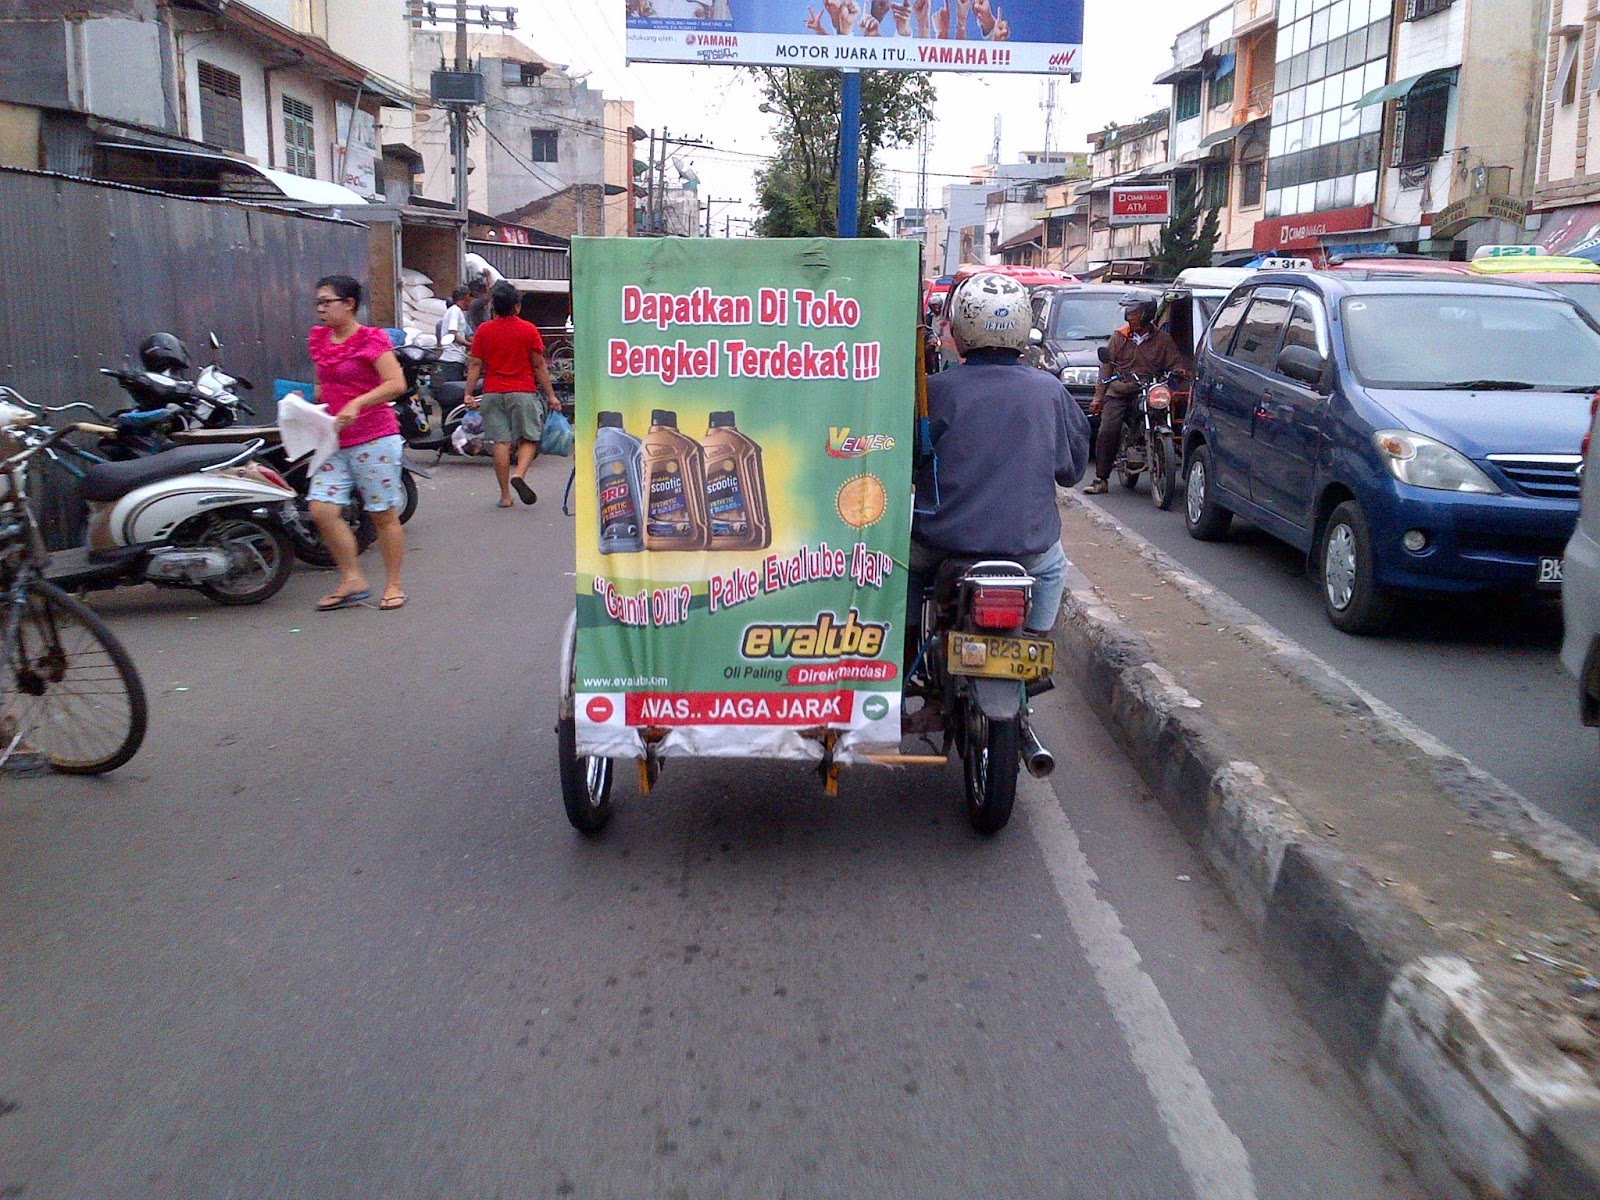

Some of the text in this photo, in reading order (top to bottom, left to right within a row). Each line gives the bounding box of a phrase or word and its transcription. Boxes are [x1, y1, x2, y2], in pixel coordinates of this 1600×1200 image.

[697, 34, 738, 47] YAMAHA
[776, 45, 830, 59] MOTOR
[834, 46, 878, 60] JUARA
[917, 46, 989, 65] YAMAHA
[991, 49, 1011, 66] !!!
[1127, 203, 1147, 211] ATM
[1489, 246, 1537, 257] 121
[1281, 259, 1296, 269] 31
[622, 286, 860, 330] Dapatkan Di Toko
[609, 339, 880, 384] Bengkel Terdekat !!!
[600, 483, 628, 503] PRO
[651, 477, 682, 494] scootic
[706, 475, 738, 494] scootic
[652, 584, 692, 626] Oli?
[709, 567, 759, 612] Pake
[764, 541, 846, 591] Evalube
[741, 608, 886, 659] evalube
[724, 666, 740, 680] Oli
[744, 666, 783, 681] Paling
[708, 698, 771, 719] JAGA
